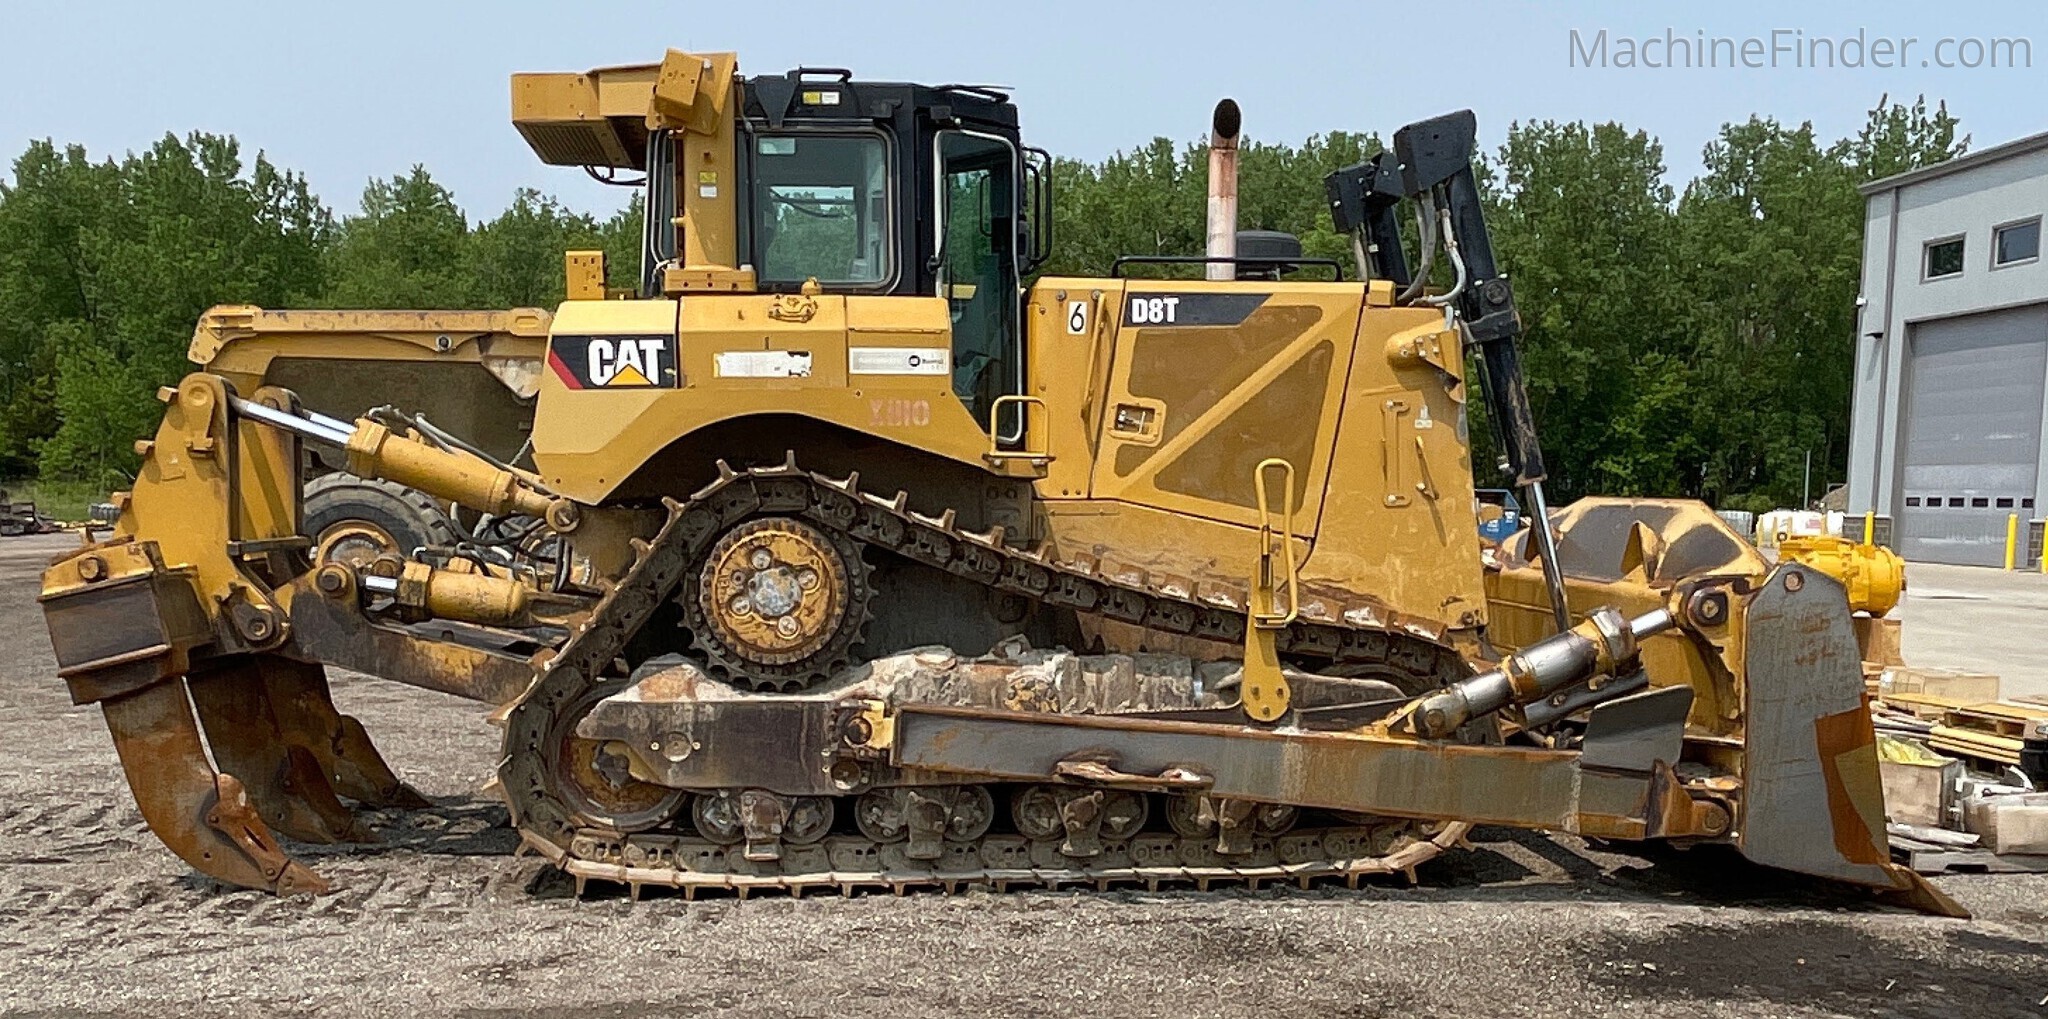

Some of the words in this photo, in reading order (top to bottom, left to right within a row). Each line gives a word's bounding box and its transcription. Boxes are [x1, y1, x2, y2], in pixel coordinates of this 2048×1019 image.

[1070, 303, 1084, 332] 6
[1131, 298, 1180, 324] D8T
[588, 339, 665, 386] CAT
